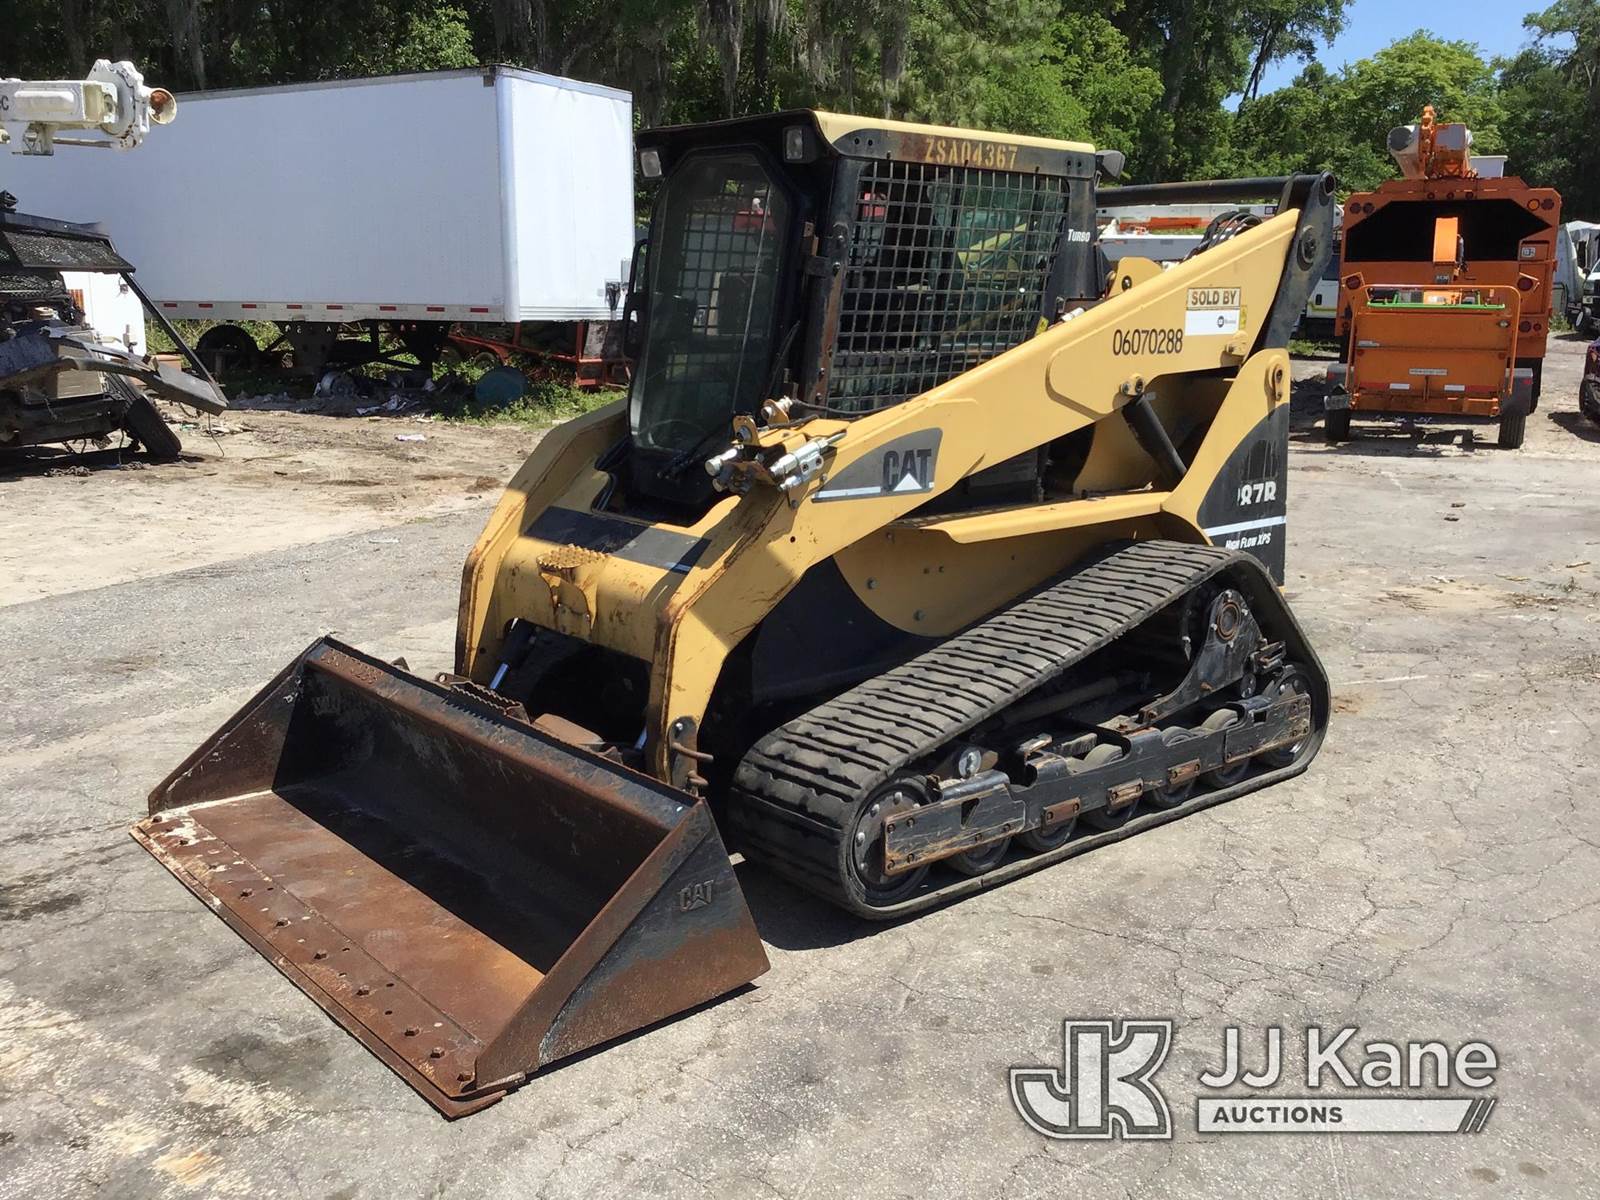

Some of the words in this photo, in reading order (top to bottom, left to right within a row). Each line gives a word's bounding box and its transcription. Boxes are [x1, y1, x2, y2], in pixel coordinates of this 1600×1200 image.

[924, 136, 1018, 170] ZSA04367
[1191, 290, 1220, 305] SOLD
[1222, 290, 1237, 305] BY
[1113, 328, 1184, 356] 06070288
[882, 448, 932, 492] CAT
[1240, 536, 1257, 549] FLOW
[1256, 532, 1272, 546] XPS
[679, 879, 714, 912] CAT
